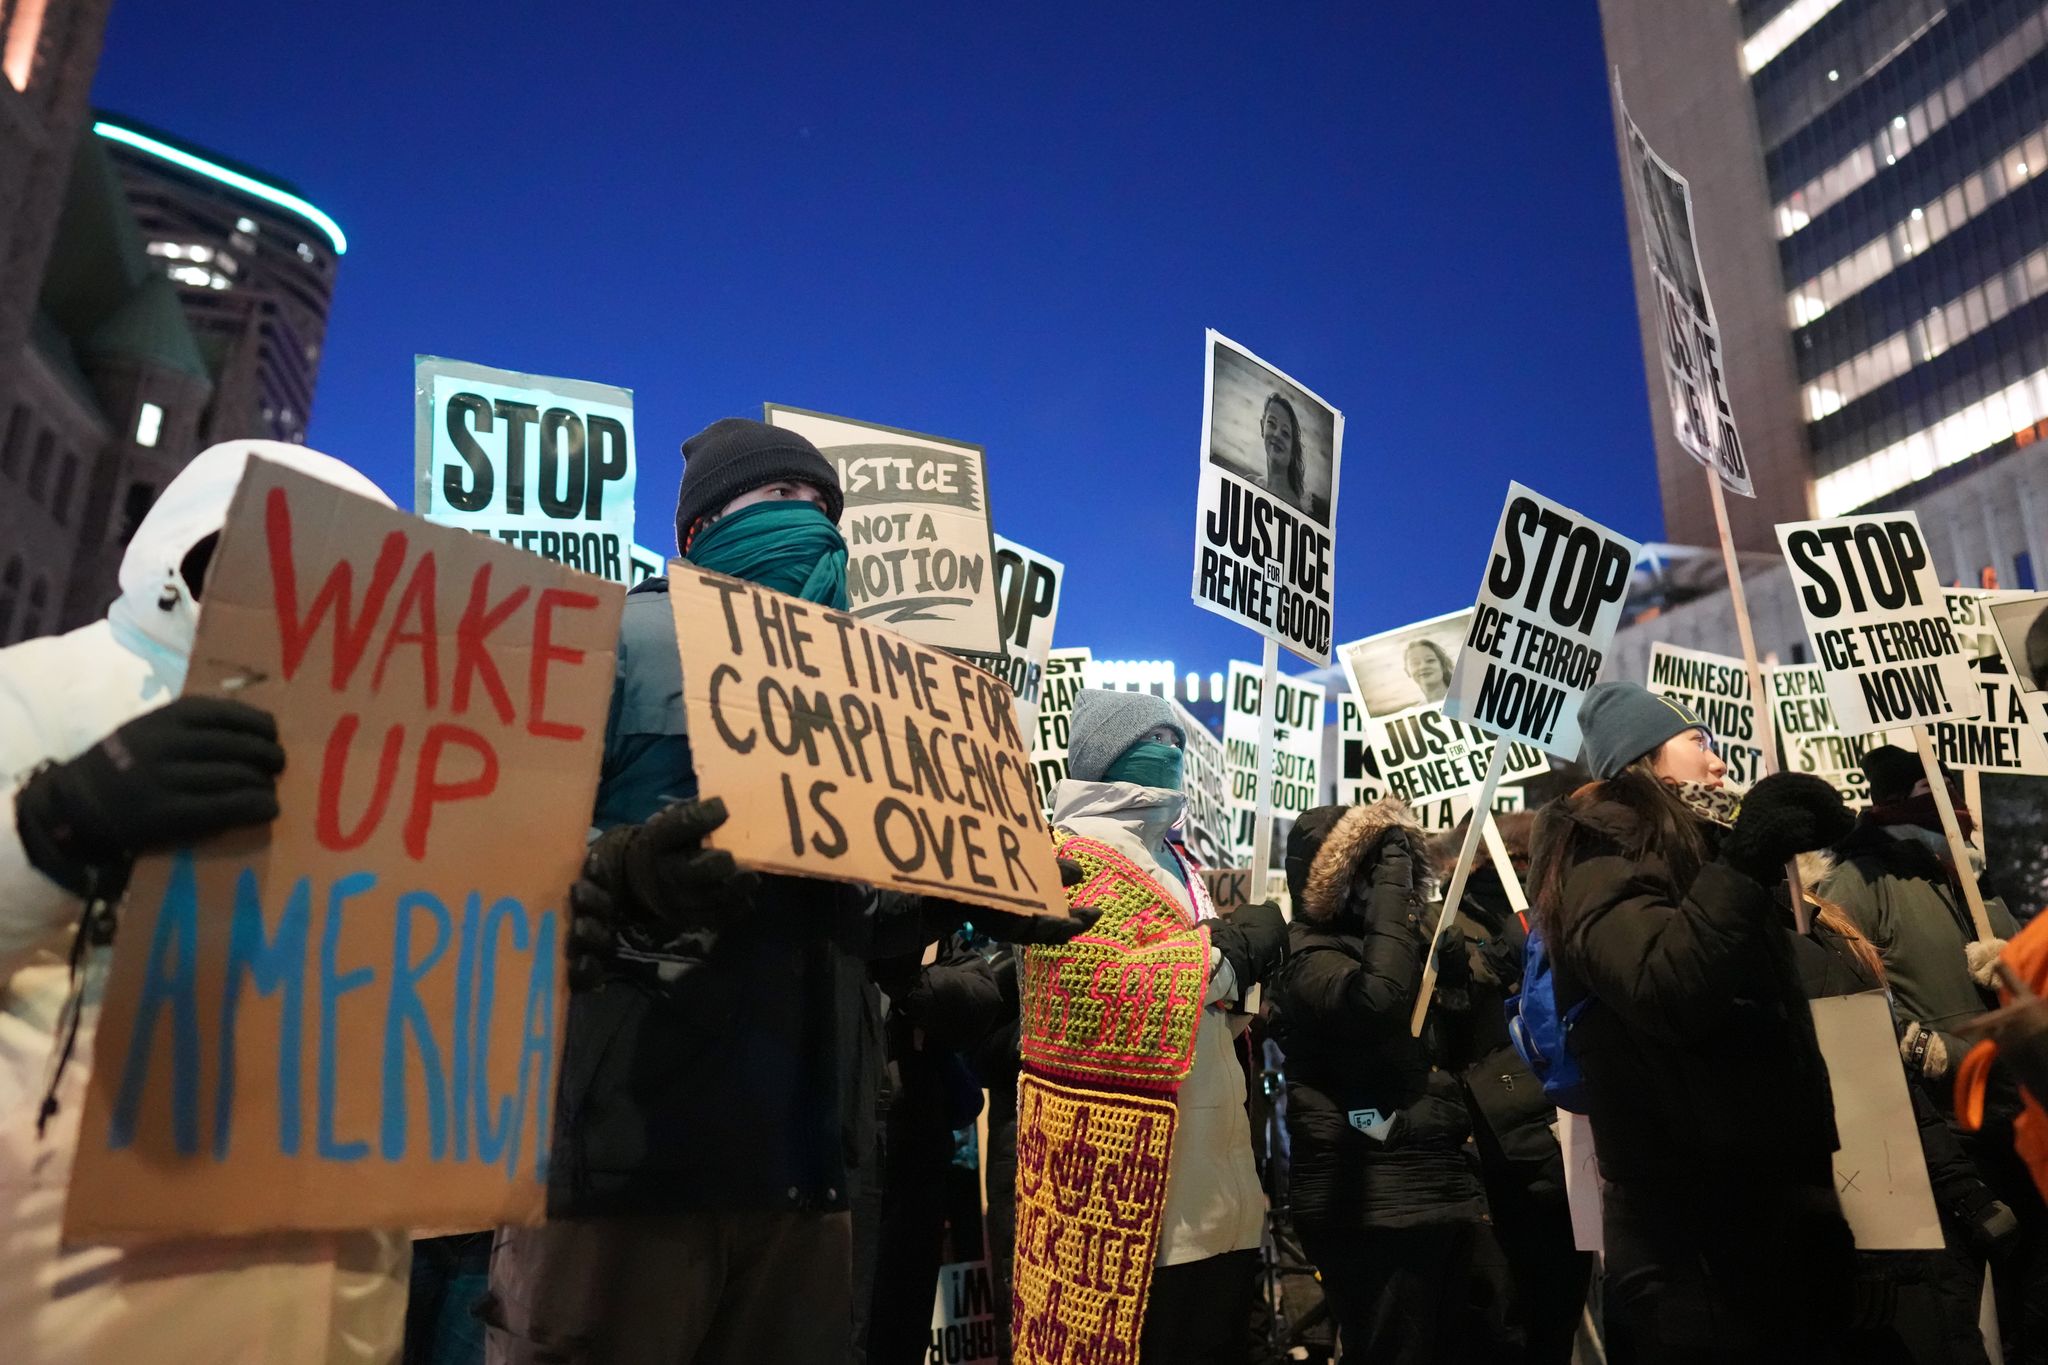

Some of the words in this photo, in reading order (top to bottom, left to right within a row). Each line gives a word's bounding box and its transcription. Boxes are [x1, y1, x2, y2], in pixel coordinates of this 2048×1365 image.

[443, 392, 627, 521] STOP
[838, 457, 958, 494] STICE
[851, 513, 912, 545] NOT
[917, 513, 938, 543] A
[1206, 477, 1330, 605] JUSTICE
[1488, 496, 1631, 636] STOP
[1787, 520, 1927, 619] STOP
[266, 486, 600, 742] WAKE
[996, 548, 1056, 650] OP
[1200, 546, 1272, 628] RENEE
[1275, 584, 1331, 656] GOOD
[1266, 563, 1280, 585] FOR
[700, 577, 820, 677] THE
[823, 613, 950, 722] TIME
[952, 665, 1025, 752] FOR
[1467, 602, 1508, 659] ICE
[1510, 621, 1603, 692] TERROR
[1773, 670, 1826, 697] EXPA
[1815, 627, 1865, 672] ICE
[1861, 616, 1960, 667] TERROR
[1038, 713, 1071, 750] FO
[1275, 685, 1320, 731] OUT
[1473, 663, 1567, 745] NOW!
[1663, 690, 1754, 741] ANDS
[1858, 663, 1953, 724] NOW!
[315, 713, 499, 860] UP
[710, 663, 1044, 832] COMPLACENCY
[1226, 737, 1316, 785] MINSOTA
[1230, 768, 1257, 801] OR
[1386, 756, 1471, 801] RENEE
[781, 771, 848, 858] IS
[874, 796, 1039, 893] OVER
[109, 850, 557, 1184] AMERICA
